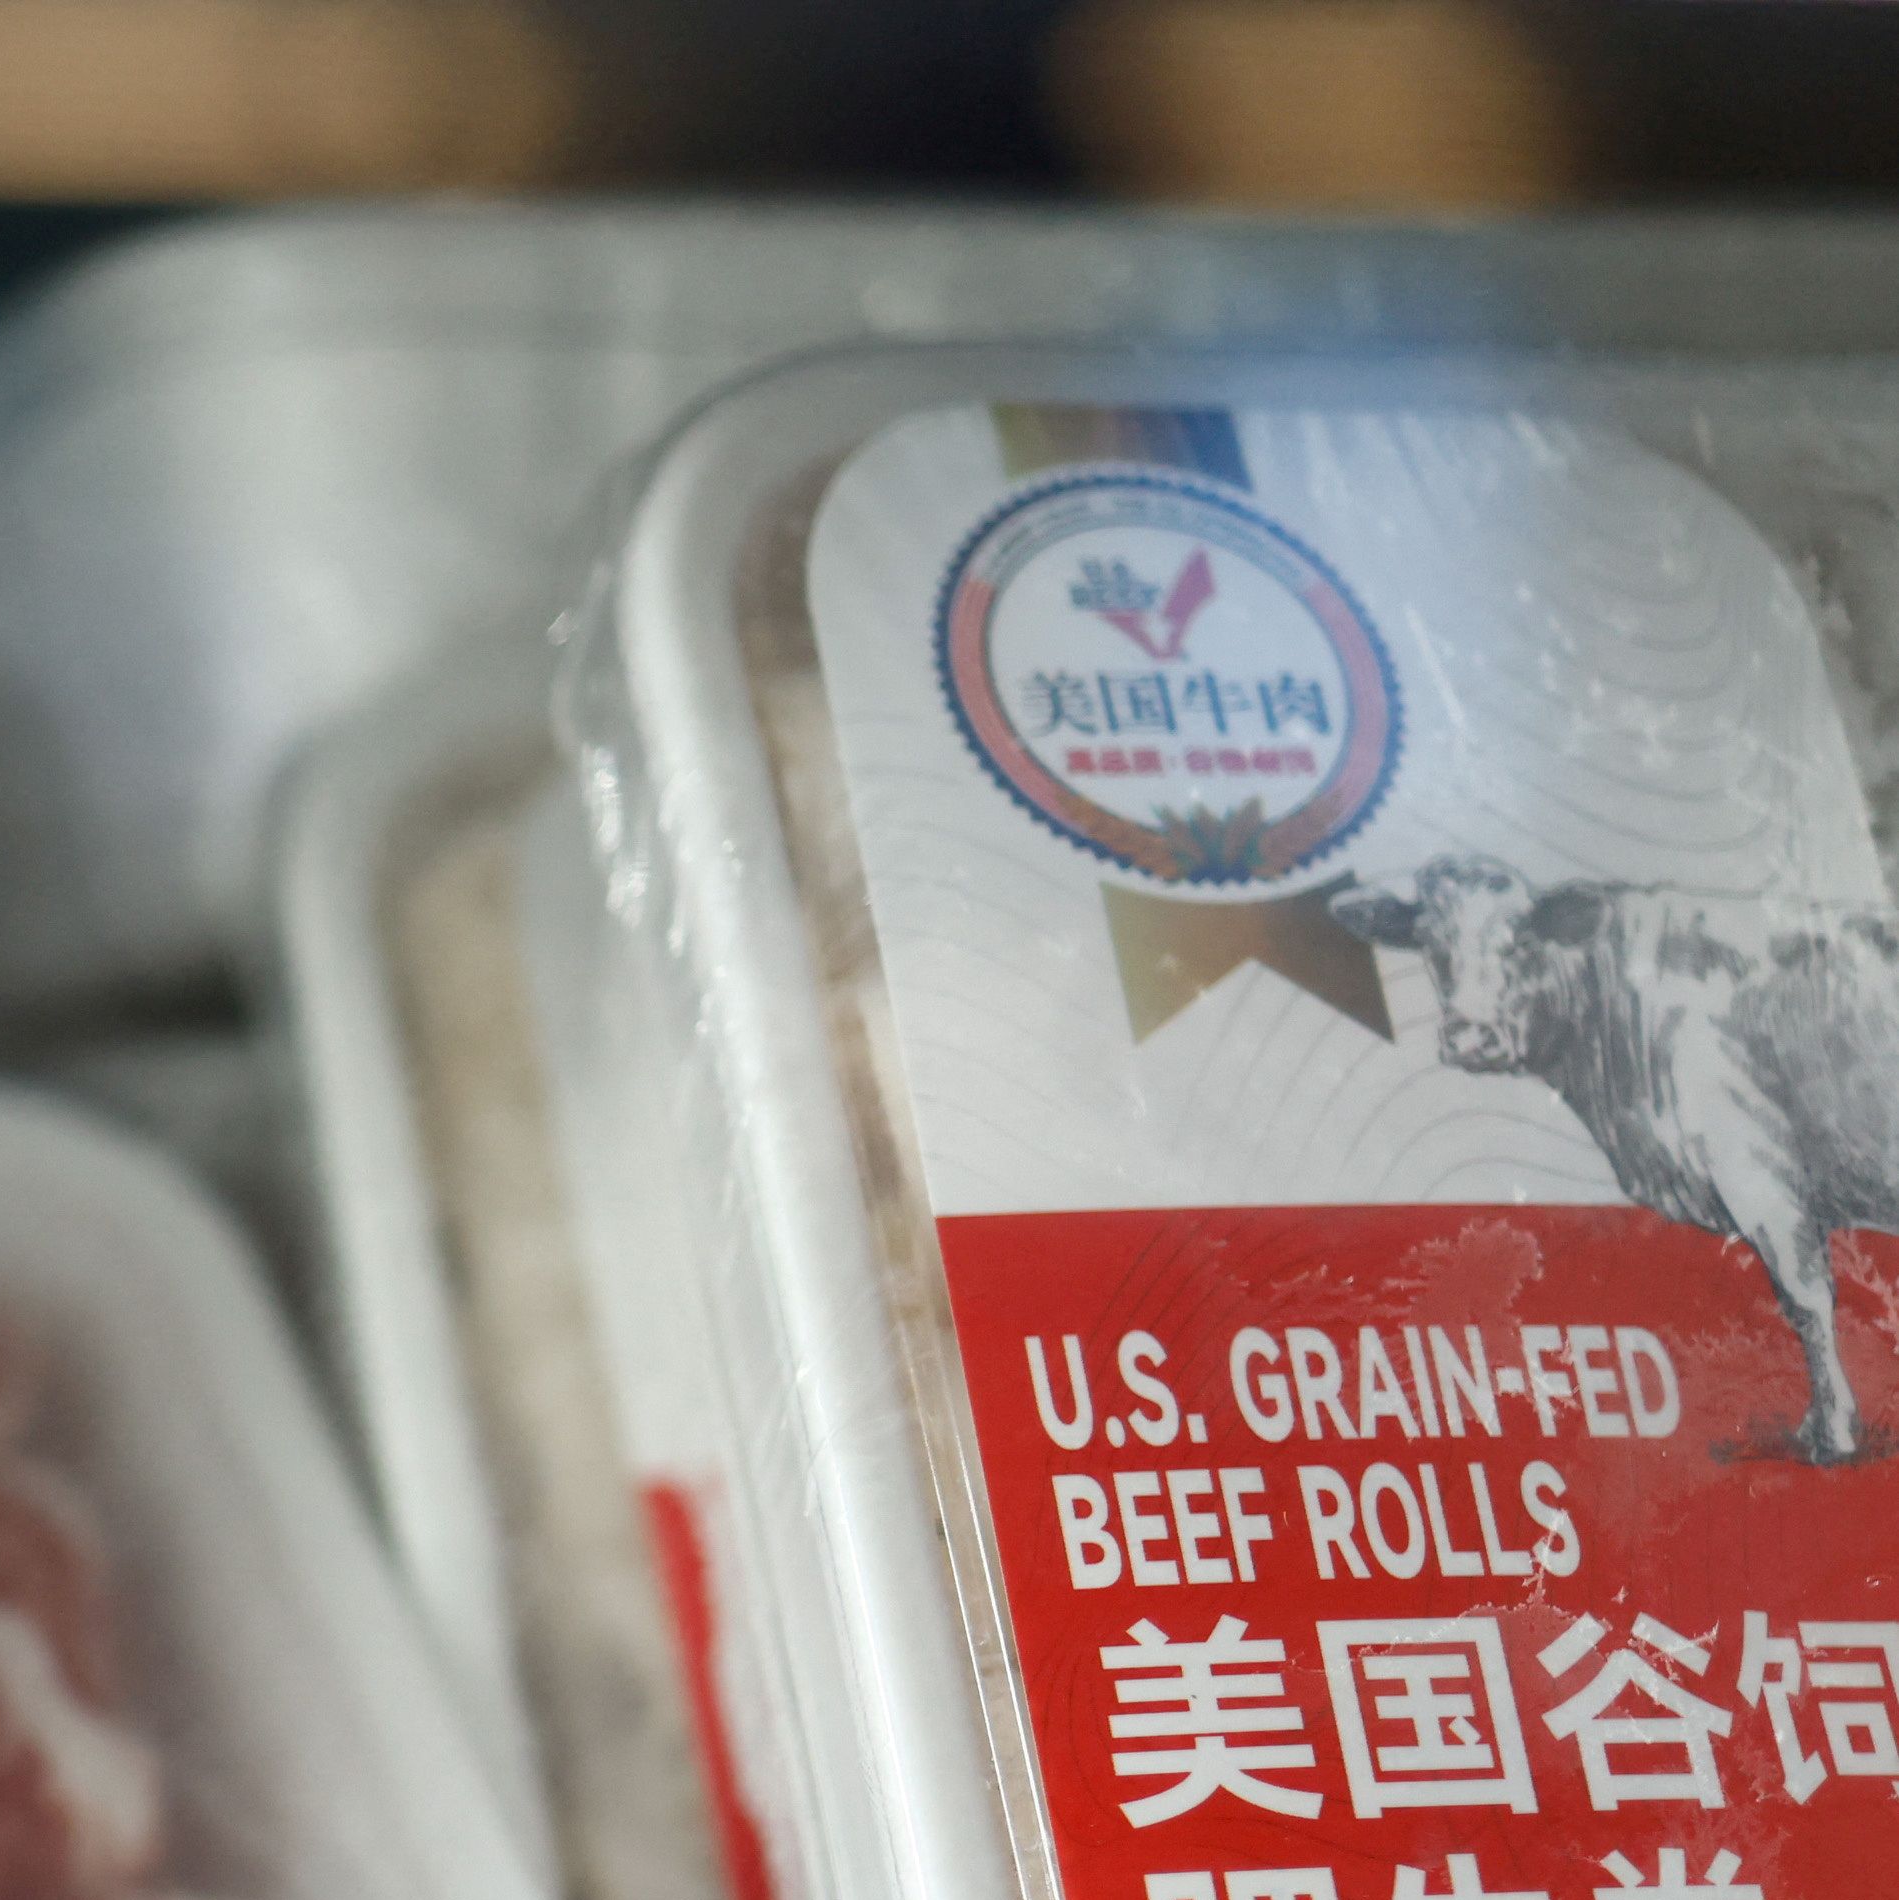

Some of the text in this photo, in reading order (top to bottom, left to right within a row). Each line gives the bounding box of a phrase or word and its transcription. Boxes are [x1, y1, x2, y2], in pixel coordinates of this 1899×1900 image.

[1021, 668, 1334, 738] 美国牛肉
[1025, 1324, 1682, 1450] U.S. GRAIN-FED
[1052, 1460, 1582, 1590] BEEF ROLLS
[1098, 1609, 1899, 1830] 美国谷饲
